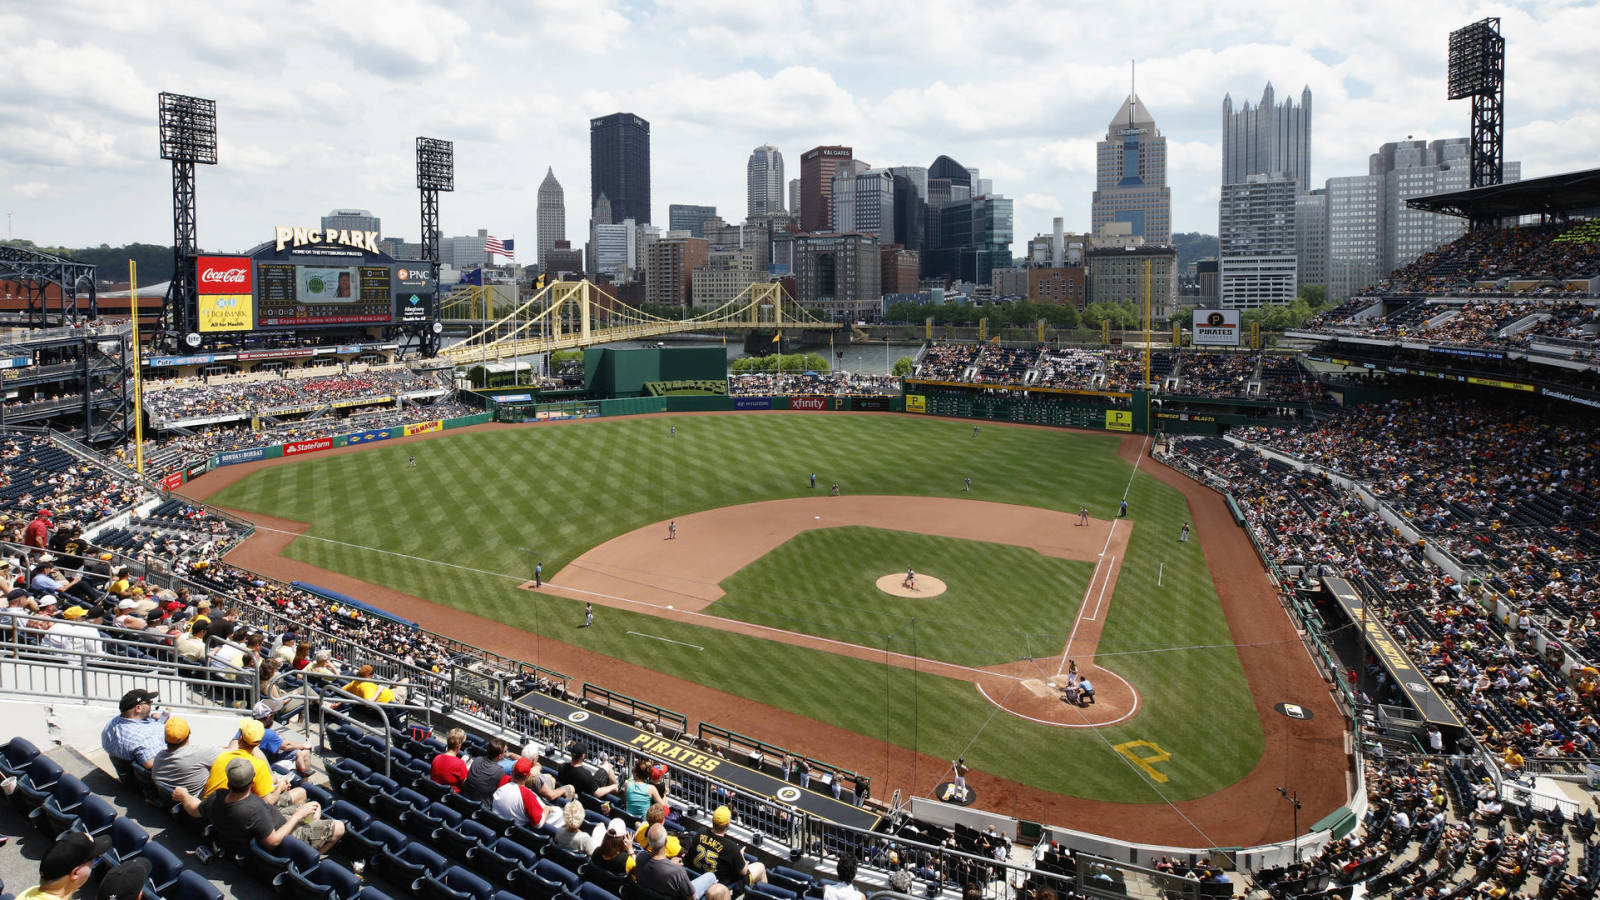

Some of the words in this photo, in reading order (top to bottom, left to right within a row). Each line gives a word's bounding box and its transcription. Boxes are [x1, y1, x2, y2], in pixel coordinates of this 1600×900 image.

[275, 225, 321, 252] PNC
[326, 228, 380, 255] PARK
[201, 268, 248, 283] Coca-Cola
[409, 270, 430, 280] PNC
[792, 398, 825, 410] xfinity
[835, 399, 843, 409] P
[1116, 412, 1123, 421] P
[630, 734, 721, 773] PIRATES
[1113, 739, 1172, 783] P
[783, 789, 794, 800] P
[699, 834, 724, 853] POLANCO
[694, 844, 720, 873] 25
